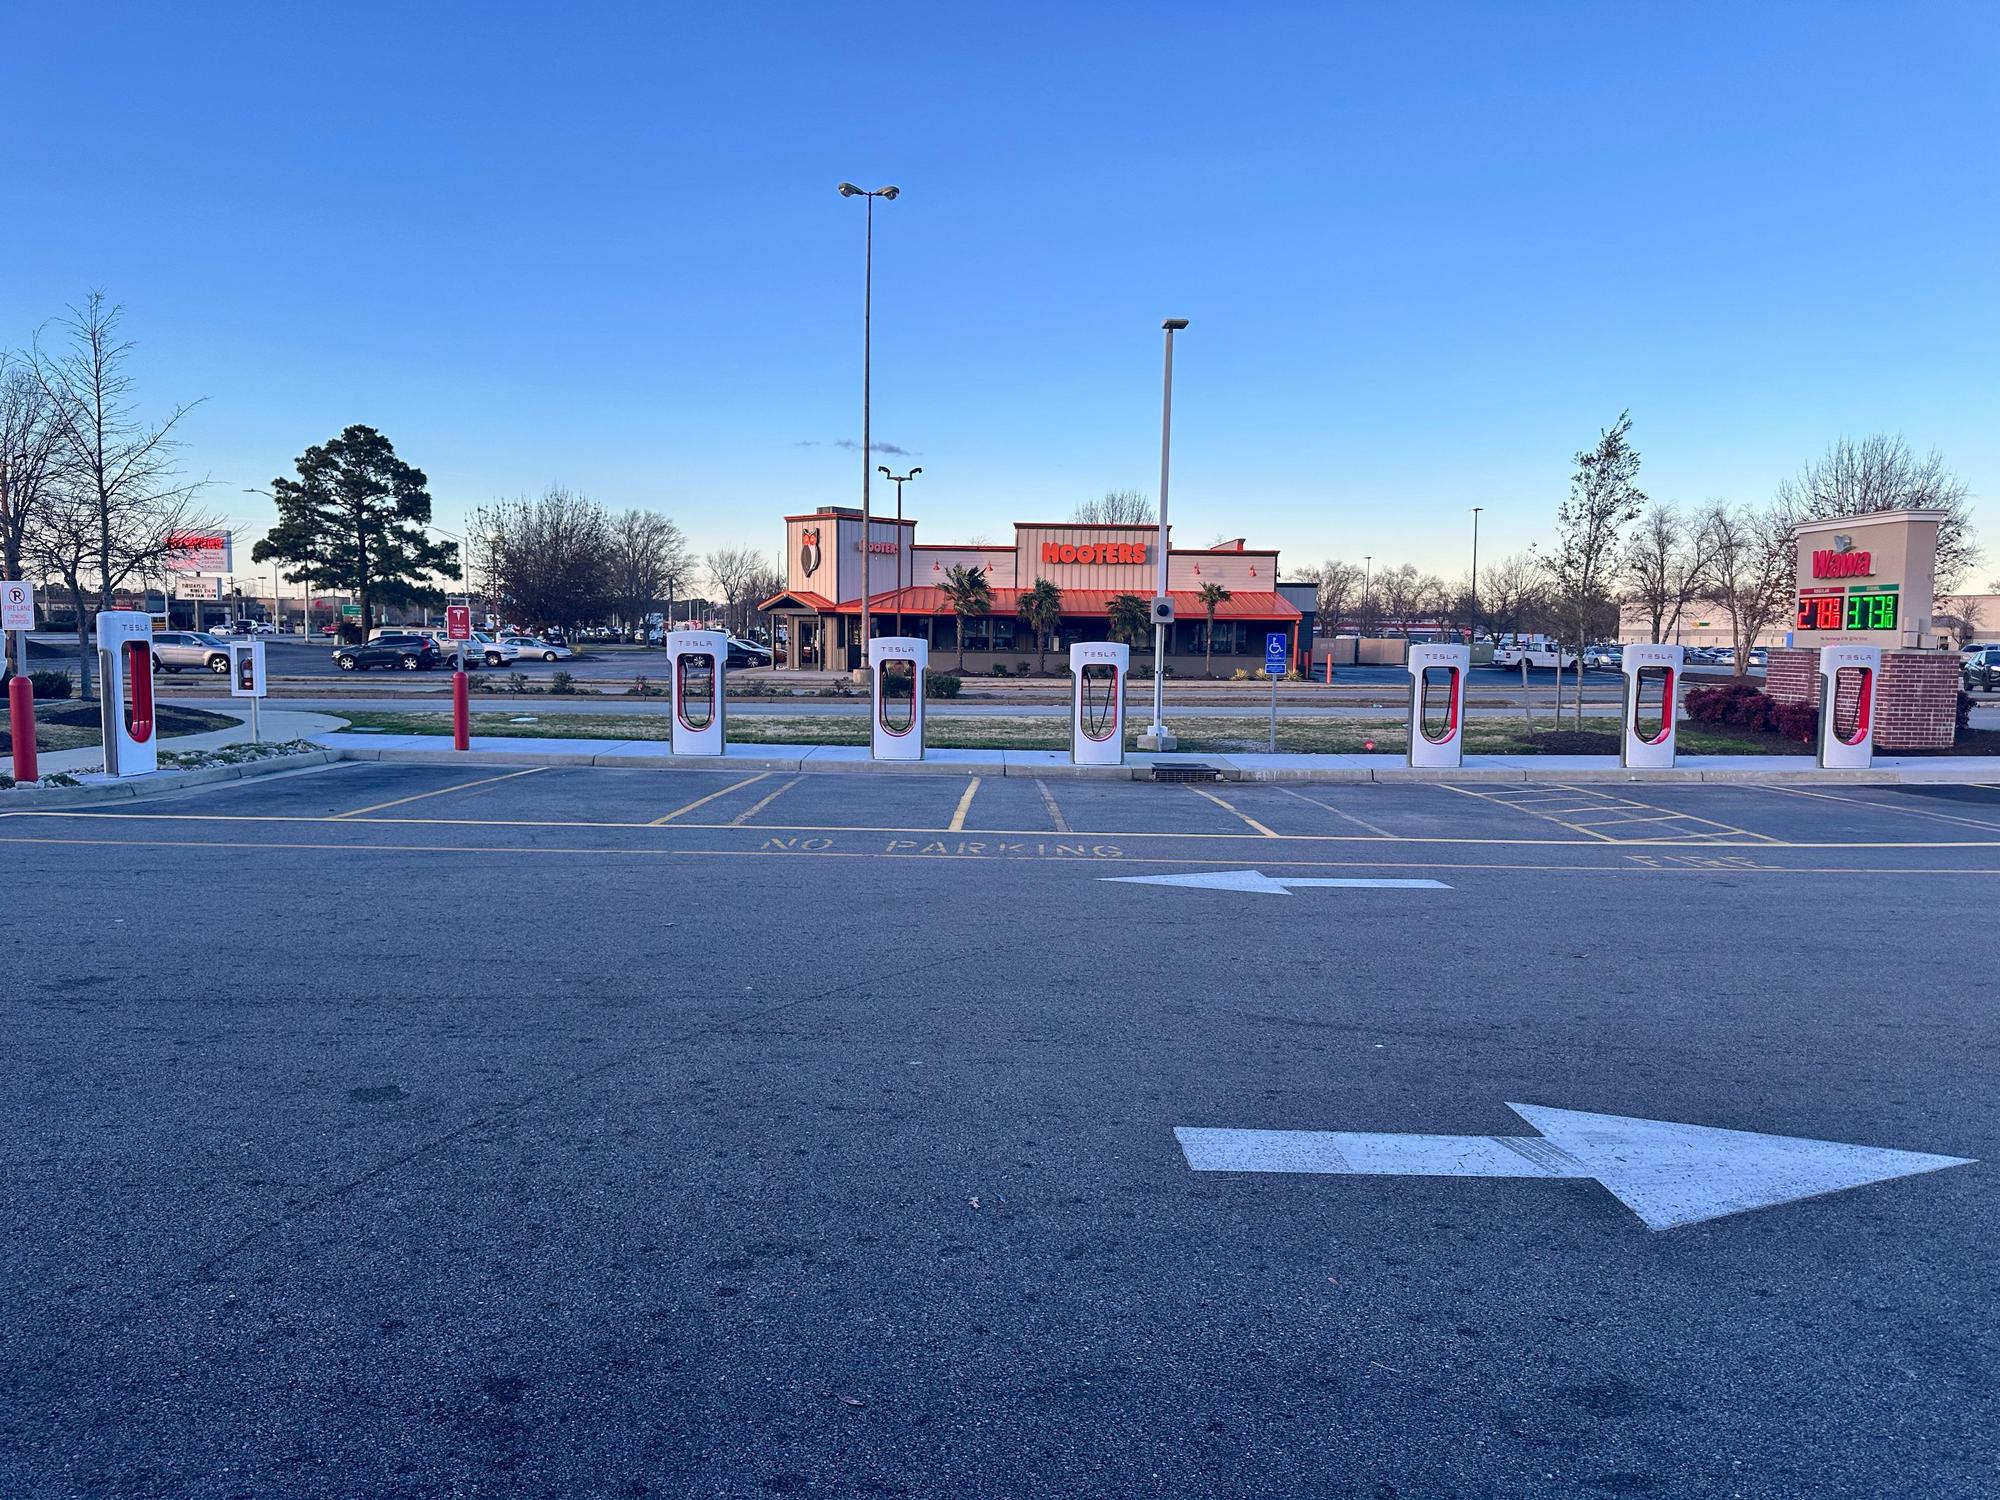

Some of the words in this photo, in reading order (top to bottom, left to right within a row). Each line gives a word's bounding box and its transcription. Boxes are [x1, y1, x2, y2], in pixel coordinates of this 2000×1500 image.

[1042, 542, 1146, 565] HOOTERS
[1813, 549, 1871, 578] Wawa
[761, 838, 833, 850] NO
[886, 840, 1123, 857] PARKING
